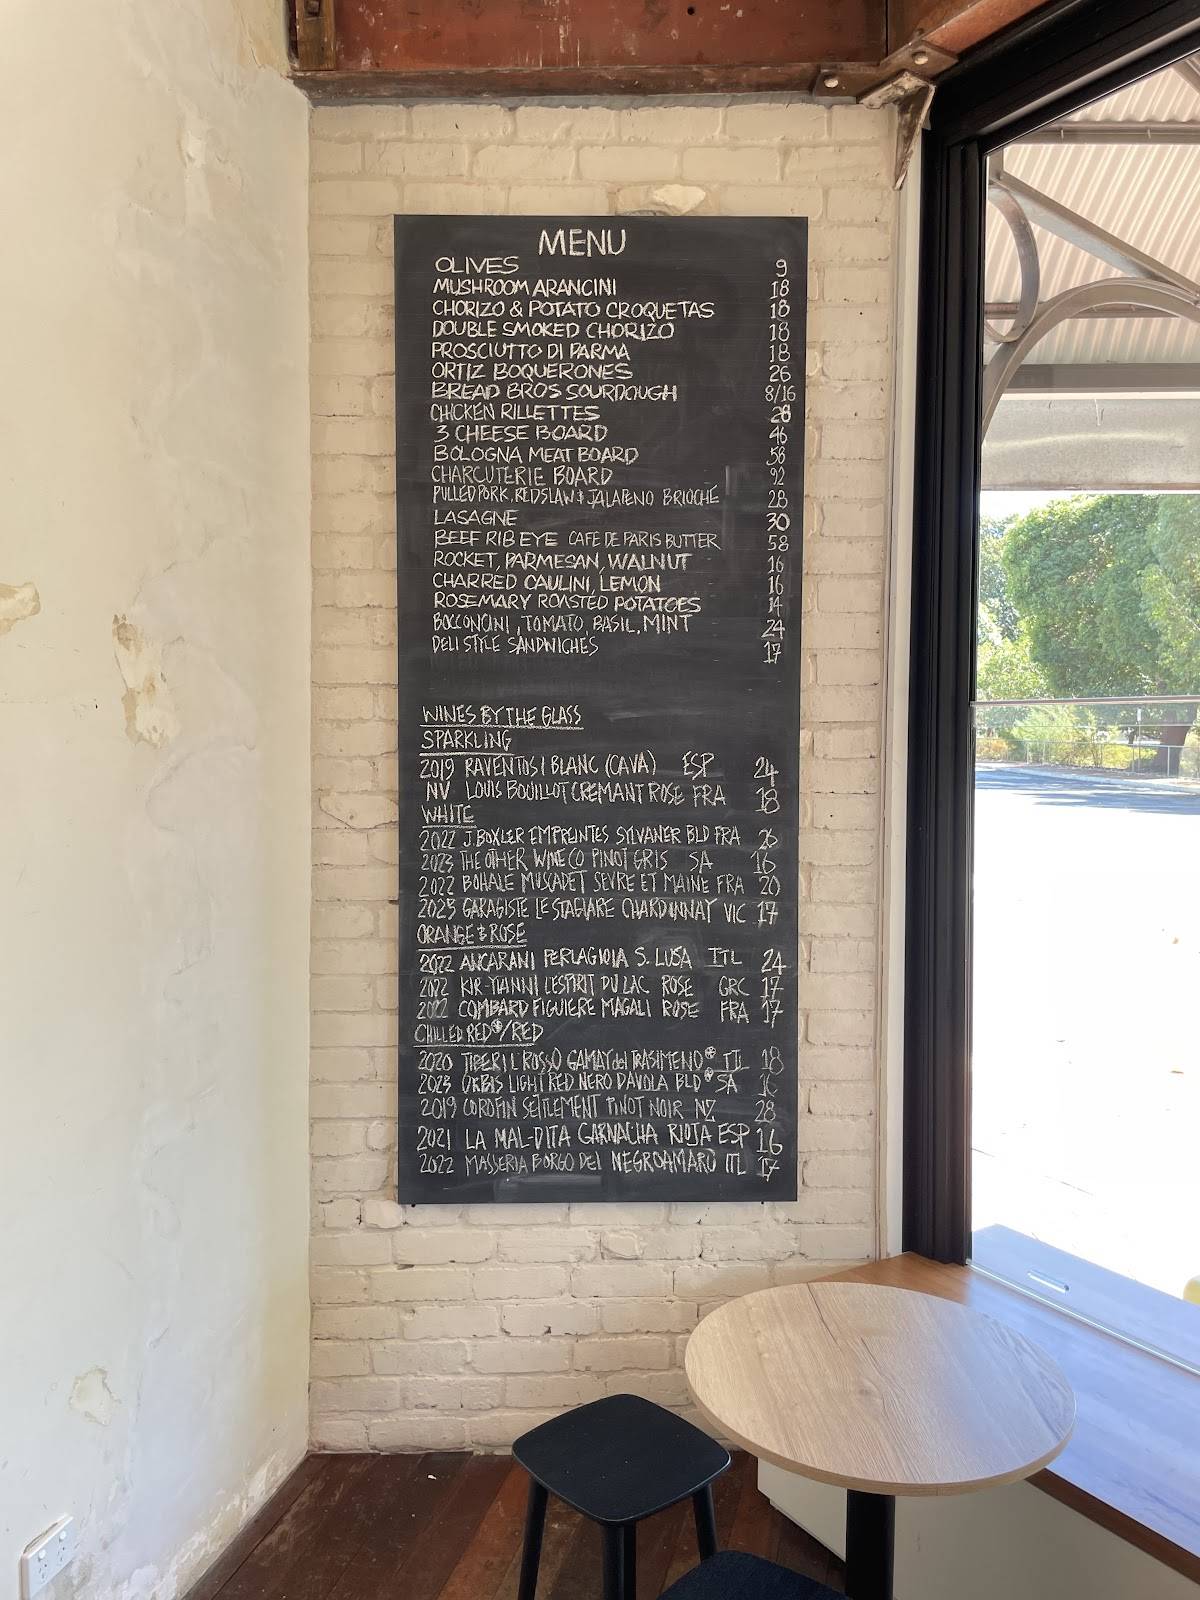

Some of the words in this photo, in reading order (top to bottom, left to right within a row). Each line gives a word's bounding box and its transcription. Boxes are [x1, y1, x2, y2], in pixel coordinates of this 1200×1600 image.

[537, 228, 627, 257] MENU
[435, 256, 520, 275] OLIVES
[775, 259, 788, 278] 9
[432, 278, 530, 297] MUSHROOM
[531, 278, 617, 298] ARANCINI
[769, 279, 790, 300] 18
[432, 300, 504, 318] CHORIZO
[509, 301, 524, 318] &
[528, 300, 601, 318] POTATO
[605, 301, 716, 320] CROQUETAS
[769, 299, 791, 319] 18
[432, 320, 497, 338] DOUBLE
[502, 321, 580, 338] SMOKED
[585, 322, 675, 342] CHORIZO
[769, 321, 791, 342] 18
[431, 342, 543, 360] PROSCIUTTO
[547, 343, 563, 360] DI
[569, 343, 631, 361] PARMA
[769, 343, 791, 363] 18
[431, 362, 487, 380] ORTIZ
[493, 362, 634, 383] BOQUERONES
[769, 364, 792, 383] 26
[431, 382, 501, 401] BREAD
[506, 382, 562, 400] BROS
[565, 383, 678, 402] SOURDOUGH
[765, 384, 796, 403] 8/16
[430, 402, 495, 422] CHICKEN
[500, 403, 601, 422] RILLETTES
[433, 425, 450, 443] 3
[455, 425, 530, 444] CHEESE
[535, 424, 608, 442] BOARD
[769, 425, 788, 446] 46
[433, 445, 523, 465] BOLOGNA
[528, 447, 575, 465] MEAT
[577, 447, 640, 466] BOARD
[766, 446, 786, 466] 58
[431, 465, 547, 486] CHARCUTERIE
[553, 466, 613, 486] BOARD
[769, 466, 785, 486] 92
[433, 485, 476, 504] PULLED
[767, 489, 788, 509] 28
[433, 509, 520, 527] LASAGNE
[766, 512, 791, 532] 30
[434, 529, 482, 549] BEEF
[486, 530, 516, 549] RIB
[519, 531, 559, 548] EYE
[568, 530, 601, 548] CAFE
[604, 531, 618, 548] DE
[623, 531, 662, 548] PARIS
[665, 532, 722, 550] BUTTER
[767, 534, 789, 552] 58
[433, 550, 501, 572] ROCKET,
[607, 552, 693, 572] WALNUT
[767, 555, 784, 574] 16
[432, 572, 517, 591] CHARRED
[599, 574, 661, 593] LEMON
[768, 574, 784, 596] 16
[434, 591, 532, 611] ROSEMARY
[537, 592, 608, 611] ROASTED
[614, 595, 702, 614] POTATOES
[768, 596, 783, 617] 14
[643, 614, 693, 634] MINT
[761, 619, 786, 640] 24
[432, 636, 459, 654] DELI
[464, 635, 500, 653] STYLE
[507, 635, 600, 656] SANDWICHES
[763, 641, 782, 664] 17
[421, 704, 476, 724] WINES
[480, 705, 502, 725] BY
[506, 706, 536, 725] THE
[541, 705, 582, 728] GLASS
[421, 730, 513, 751] SPARKLING
[420, 757, 455, 780] 2019
[465, 756, 538, 778] RAVENTOS
[551, 754, 599, 775] BLANC
[605, 750, 657, 776] (CAVA)
[682, 751, 715, 780] ESP
[754, 756, 779, 787] 24
[426, 781, 450, 801] NV
[465, 779, 502, 800] LOUIS
[571, 781, 645, 804] CREMANT
[649, 782, 685, 805] ROSE
[692, 785, 726, 807] FRA
[755, 786, 780, 814] 18
[421, 803, 475, 824] WHITE
[419, 829, 456, 850] 2022
[714, 825, 741, 845] FRA
[460, 850, 481, 871] THE
[533, 848, 566, 870] WINE
[592, 848, 627, 870] PINOT
[633, 849, 669, 870] GRIS
[689, 850, 714, 873] SA
[750, 851, 776, 874] 16
[419, 875, 455, 897] 2022
[594, 871, 635, 892] SEVRE
[641, 872, 657, 892] ET
[664, 872, 709, 894] MAINE
[717, 873, 744, 896] FRA
[758, 875, 781, 897] 20
[535, 897, 549, 920] LE
[724, 903, 746, 923] VIC
[758, 901, 778, 926] 17
[761, 949, 786, 975] 24
[601, 974, 618, 993] DU
[623, 975, 650, 994] LAC
[661, 974, 693, 997] ROSE
[719, 976, 750, 996] GRC
[662, 998, 700, 1020] ROSE
[721, 999, 749, 1023] FRA
[414, 1024, 463, 1044] CHILLED
[418, 1050, 453, 1072] 2020
[650, 1097, 684, 1120] NOIR
[695, 1098, 716, 1122] NZ
[755, 1100, 777, 1124] 28
[417, 1126, 450, 1151] 2021
[465, 1128, 487, 1150] LA
[667, 1122, 712, 1146] RIOJA
[718, 1122, 750, 1148] ESP
[756, 1128, 782, 1155] 16
[419, 1153, 454, 1174] 2022
[532, 1152, 574, 1172] BORGO
